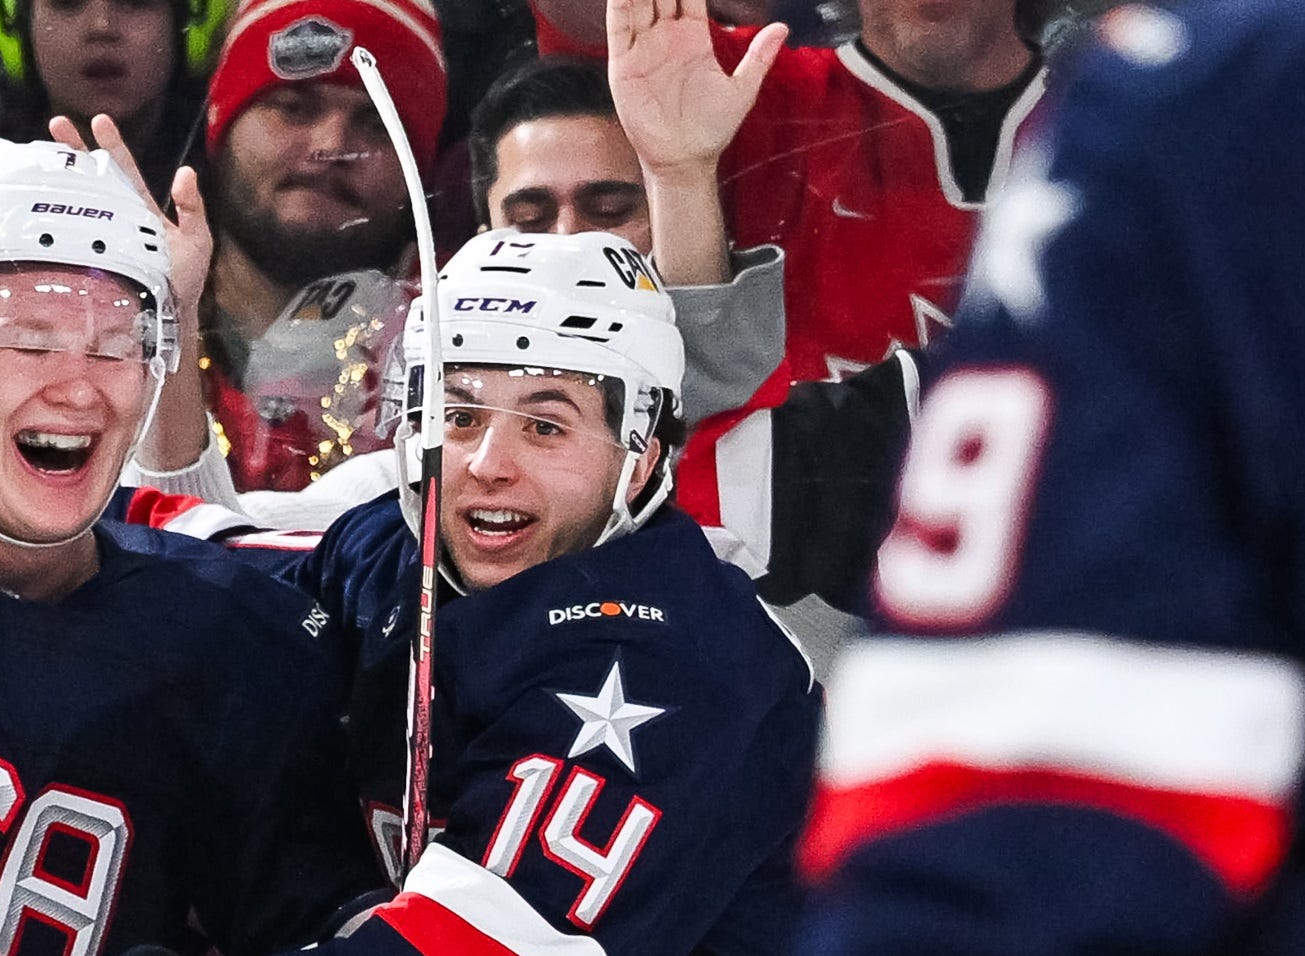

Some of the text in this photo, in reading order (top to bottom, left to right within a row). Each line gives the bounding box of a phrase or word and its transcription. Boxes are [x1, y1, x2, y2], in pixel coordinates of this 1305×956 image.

[453, 297, 538, 314] CCM
[873, 363, 1056, 630] 9
[419, 564, 434, 662] TRUE
[548, 601, 665, 625] DISCOVER
[480, 753, 663, 932] 14
